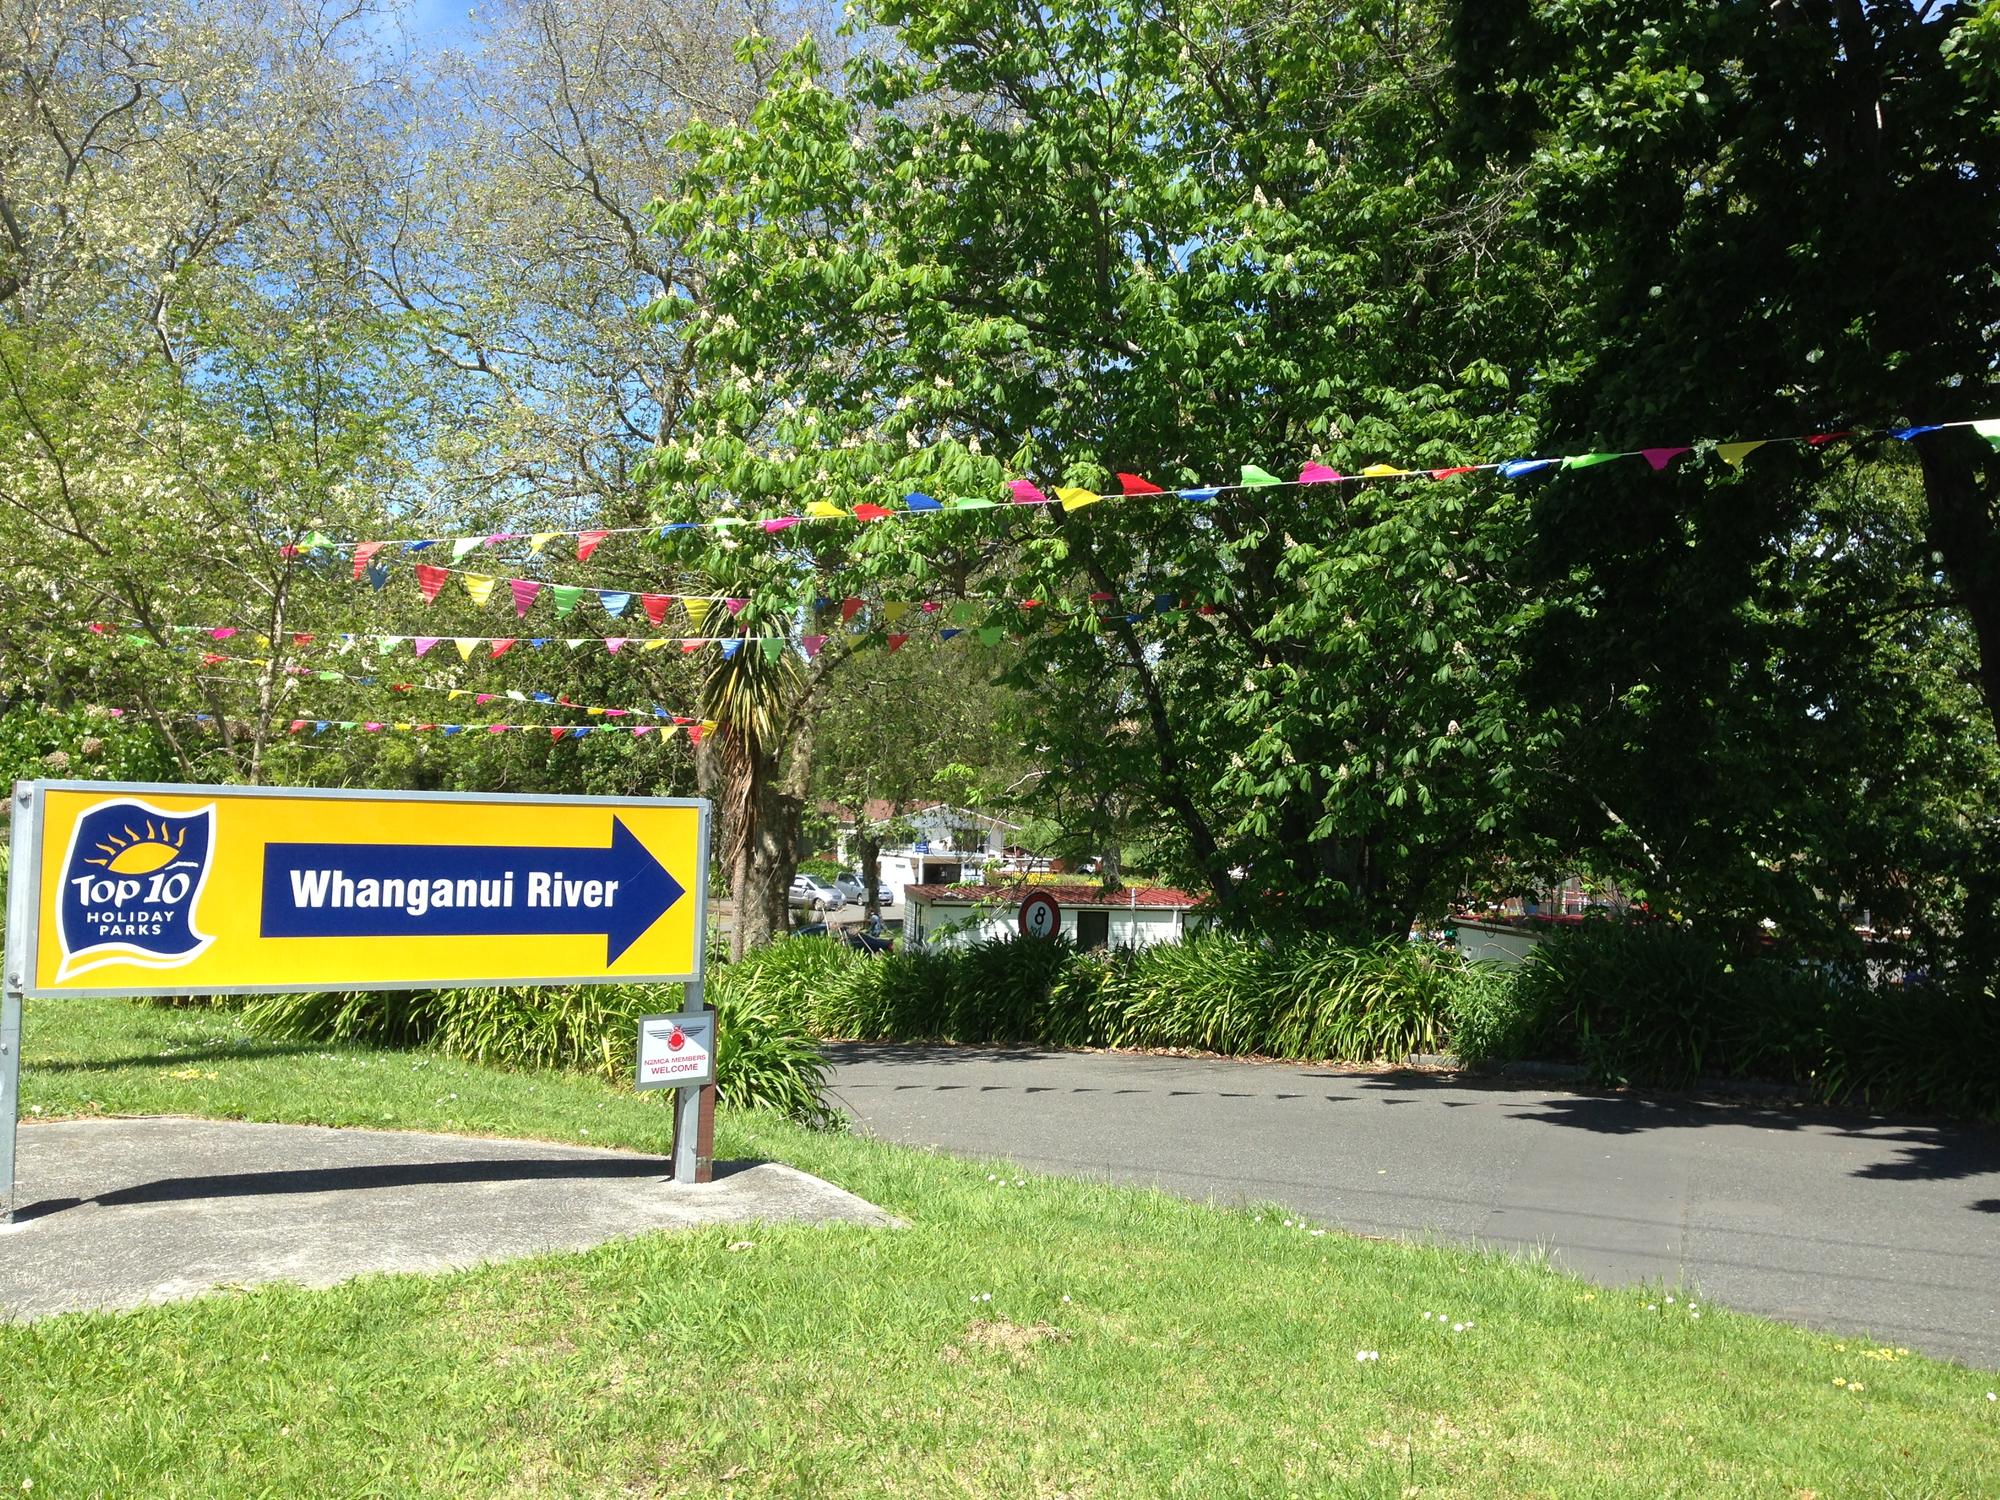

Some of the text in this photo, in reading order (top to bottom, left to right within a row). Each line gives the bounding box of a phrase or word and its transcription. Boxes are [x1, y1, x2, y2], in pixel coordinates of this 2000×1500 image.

[71, 873, 190, 908] Top 10
[290, 870, 619, 916] Whanganui River
[87, 911, 175, 923] HOLIDAY
[1035, 907, 1045, 925] 8
[100, 924, 161, 935] PARKS
[671, 1054, 706, 1063] MEMBERS
[651, 1063, 698, 1074] WELCOME
